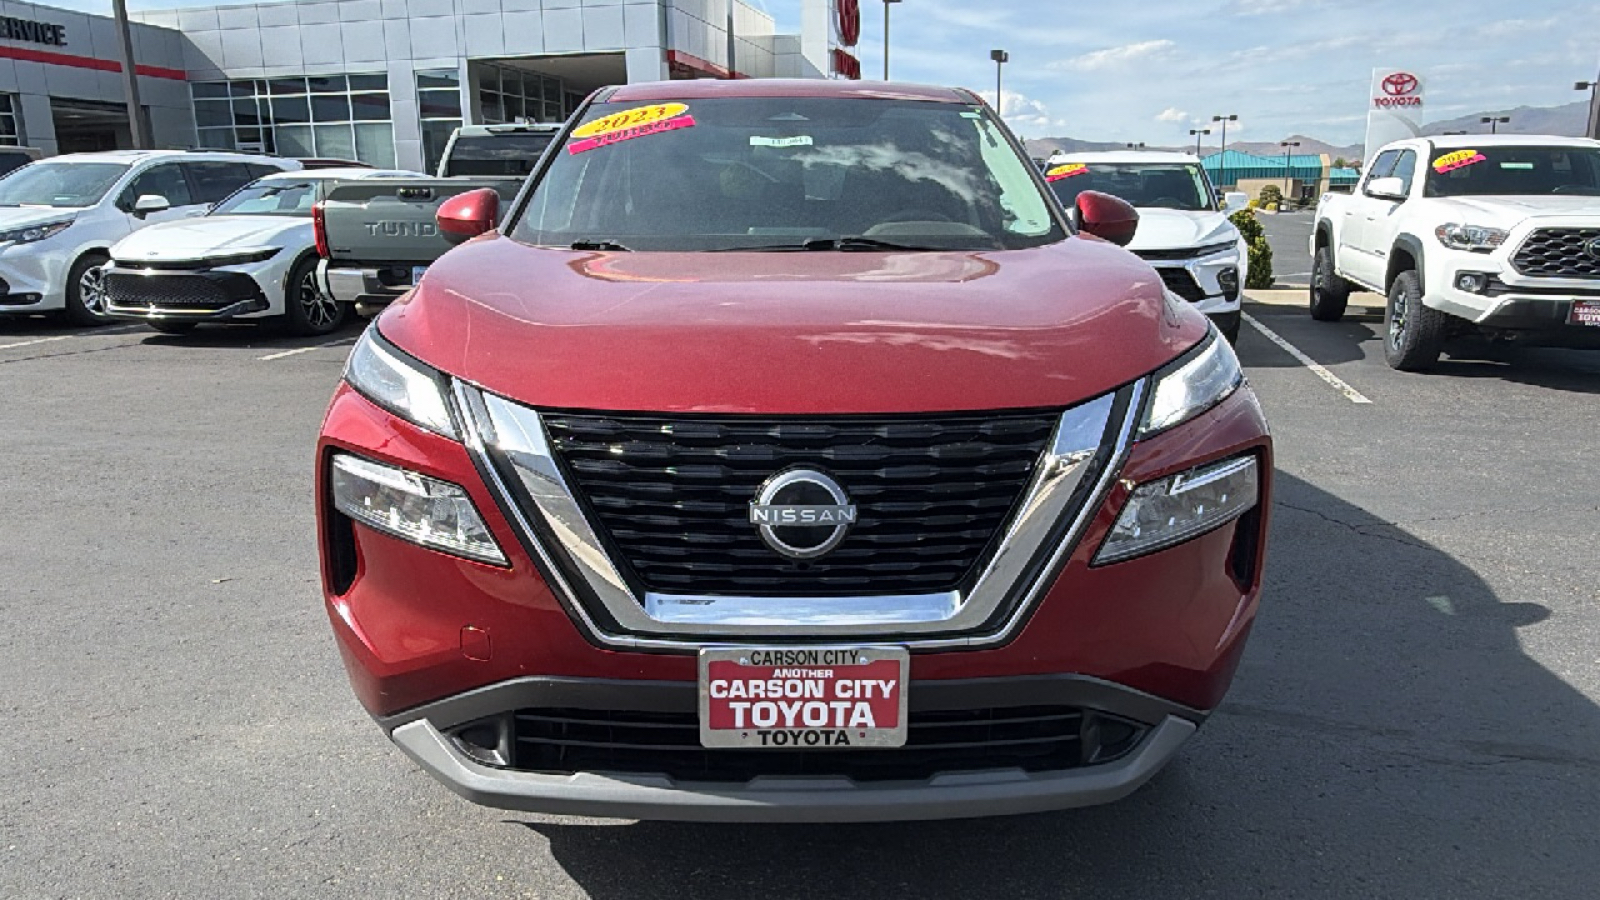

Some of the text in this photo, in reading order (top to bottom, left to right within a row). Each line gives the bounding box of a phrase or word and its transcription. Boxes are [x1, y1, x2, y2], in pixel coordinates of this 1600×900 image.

[1374, 97, 1421, 106] TOYOTA
[595, 106, 666, 133] 2023
[364, 220, 442, 237] TUND
[753, 508, 854, 522] NISSAN
[750, 650, 859, 665] CARSON CITY
[772, 668, 834, 678] ANOTHER
[710, 679, 896, 699] CARSON CITY
[728, 701, 876, 728] TOYOTA
[757, 730, 850, 746] TOYOTA
